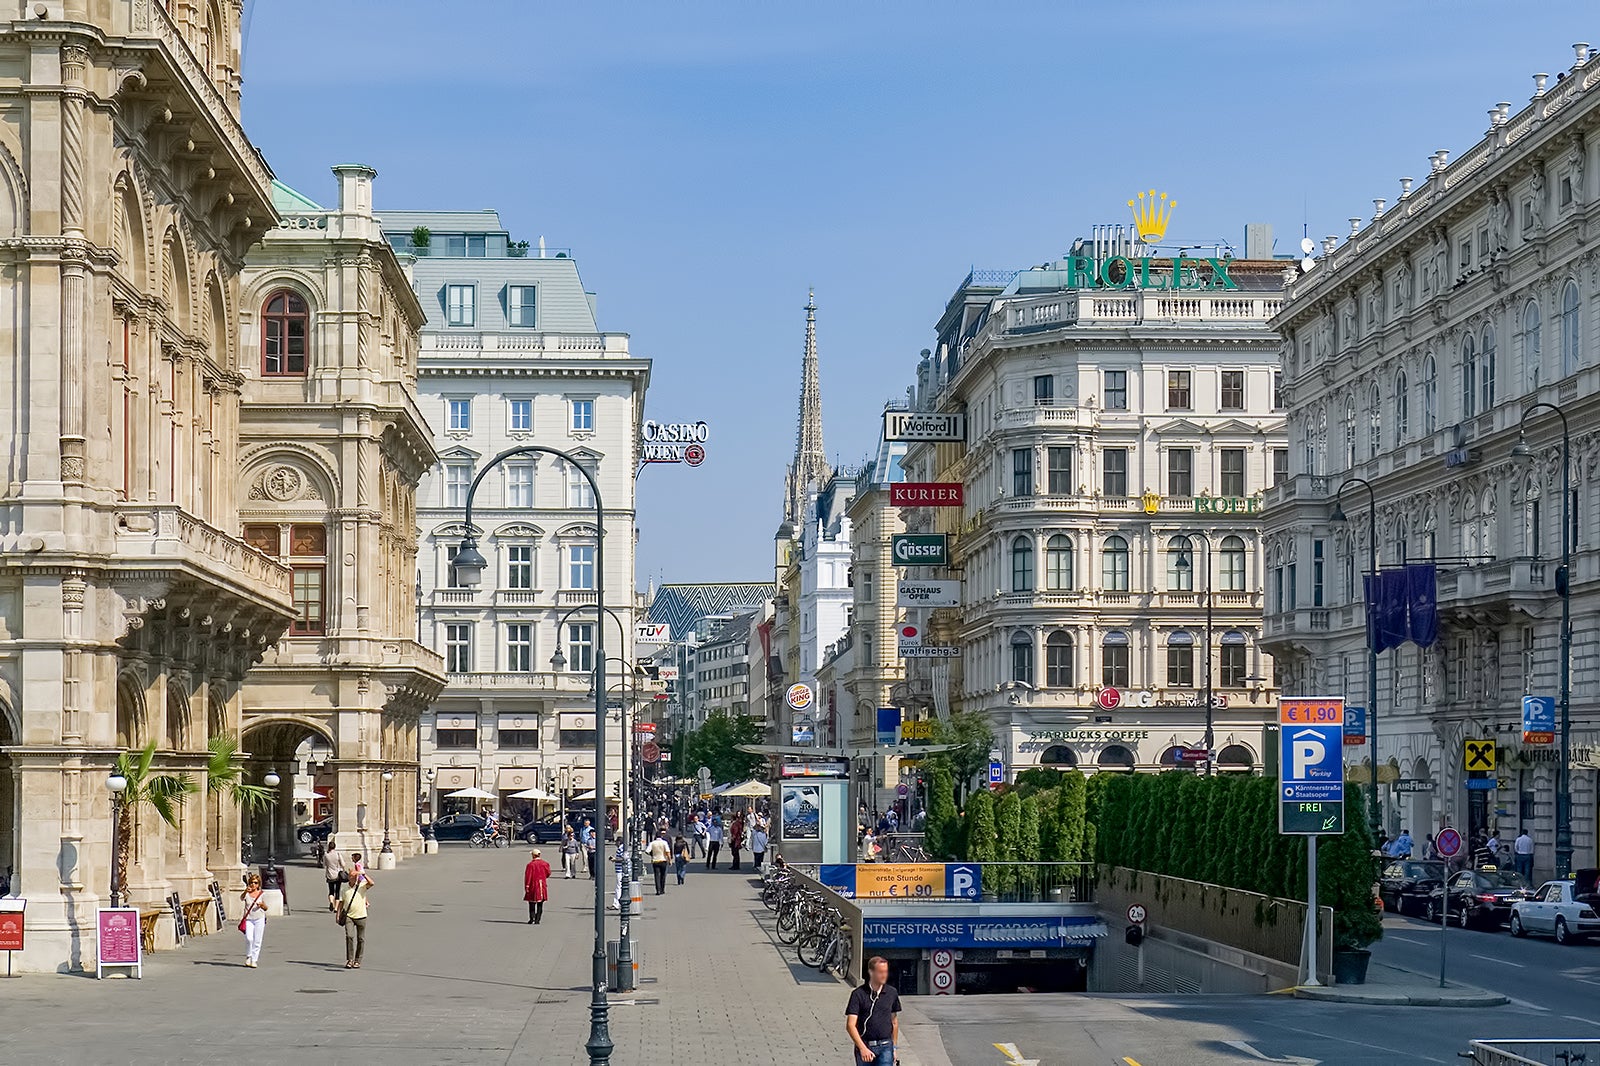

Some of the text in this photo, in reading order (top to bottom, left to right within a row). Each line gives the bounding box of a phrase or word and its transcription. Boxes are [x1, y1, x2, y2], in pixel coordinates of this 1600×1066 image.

[1065, 255, 1238, 290] ROLEX
[642, 420, 709, 443] CASINO
[904, 421, 946, 431] Wolford
[642, 444, 680, 459] WIEN
[895, 489, 959, 500] KURIER
[895, 538, 942, 560] Gösser
[789, 687, 809, 698] BURGER
[791, 693, 811, 704] KING
[1124, 691, 1152, 707] LG
[1288, 707, 1336, 723] € 1,90
[1031, 731, 1149, 739] STARBUCKS COFFEE
[1293, 741, 1326, 779] P
[1299, 803, 1322, 812] FREI
[888, 884, 898, 897] €
[938, 975, 947, 985] 10
